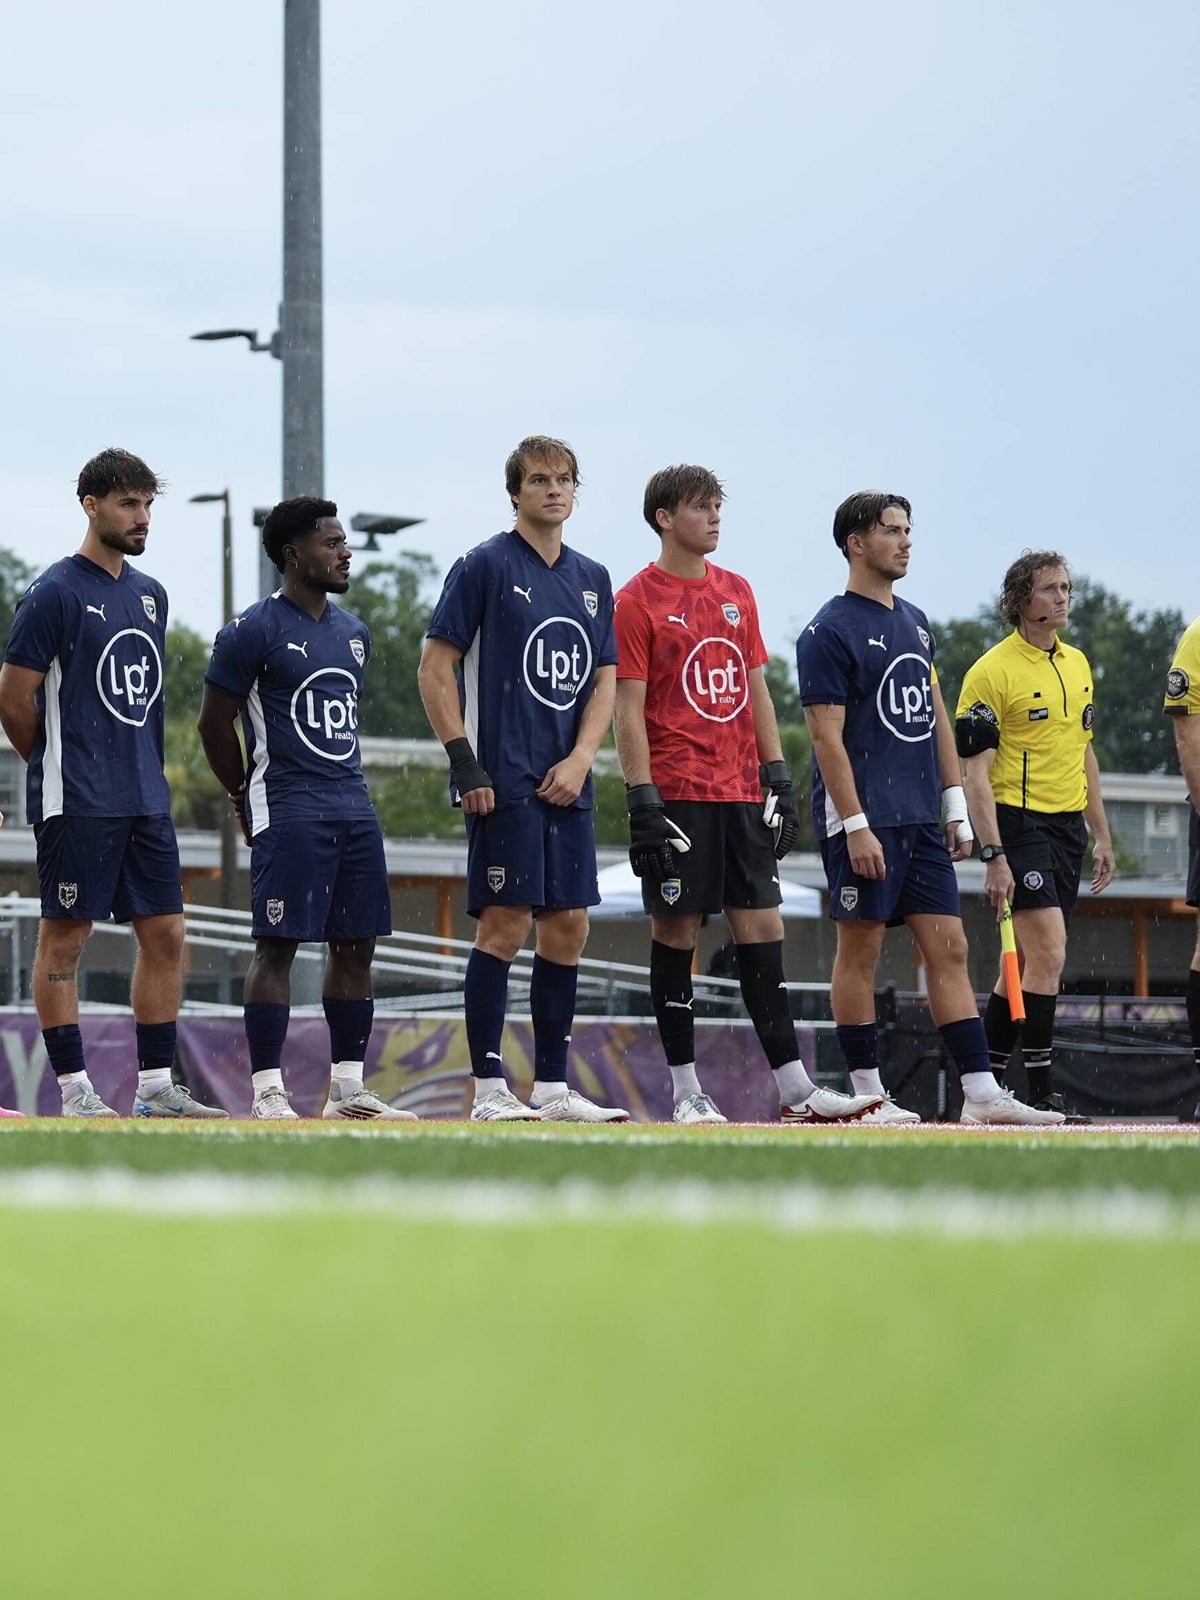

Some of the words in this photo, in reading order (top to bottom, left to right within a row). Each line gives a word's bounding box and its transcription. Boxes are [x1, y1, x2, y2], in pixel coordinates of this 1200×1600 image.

[536, 638, 580, 689] lpt
[694, 659, 741, 704] lpt
[306, 689, 356, 739] lpt
[889, 677, 932, 723] lpt
